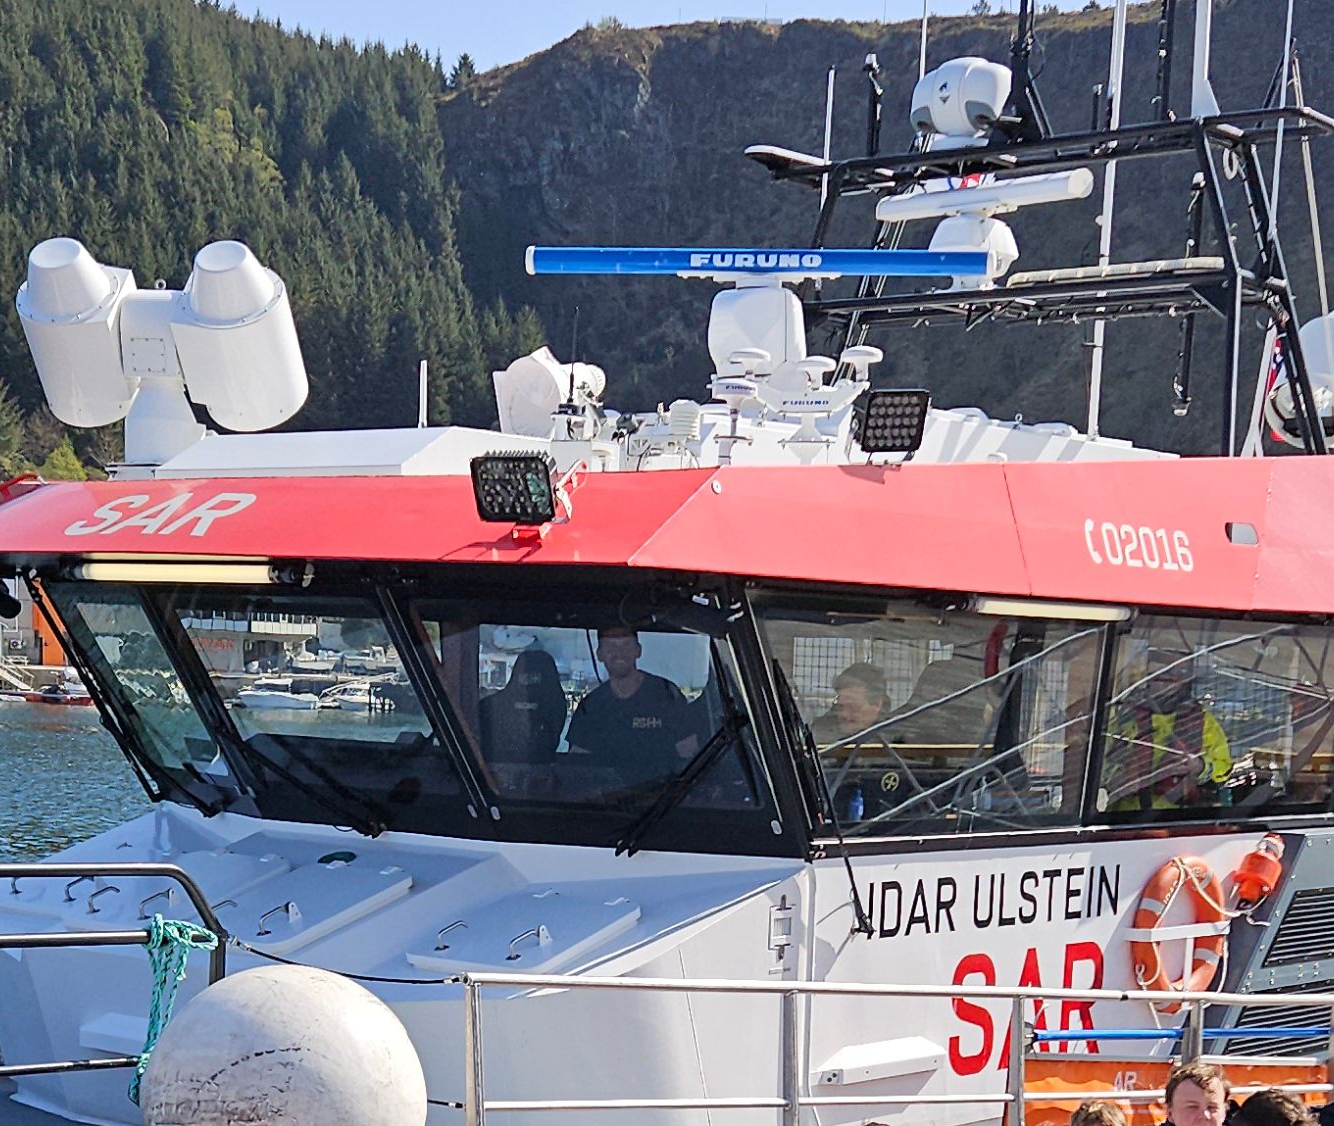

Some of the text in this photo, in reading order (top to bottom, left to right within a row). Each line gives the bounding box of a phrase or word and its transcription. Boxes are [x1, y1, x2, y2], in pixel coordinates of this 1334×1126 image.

[689, 253, 823, 268] FURUNO
[63, 492, 257, 537] SAR
[1102, 521, 1194, 571] 02016
[973, 864, 1121, 929] ULSTEIN
[948, 941, 1104, 1077] SAR
